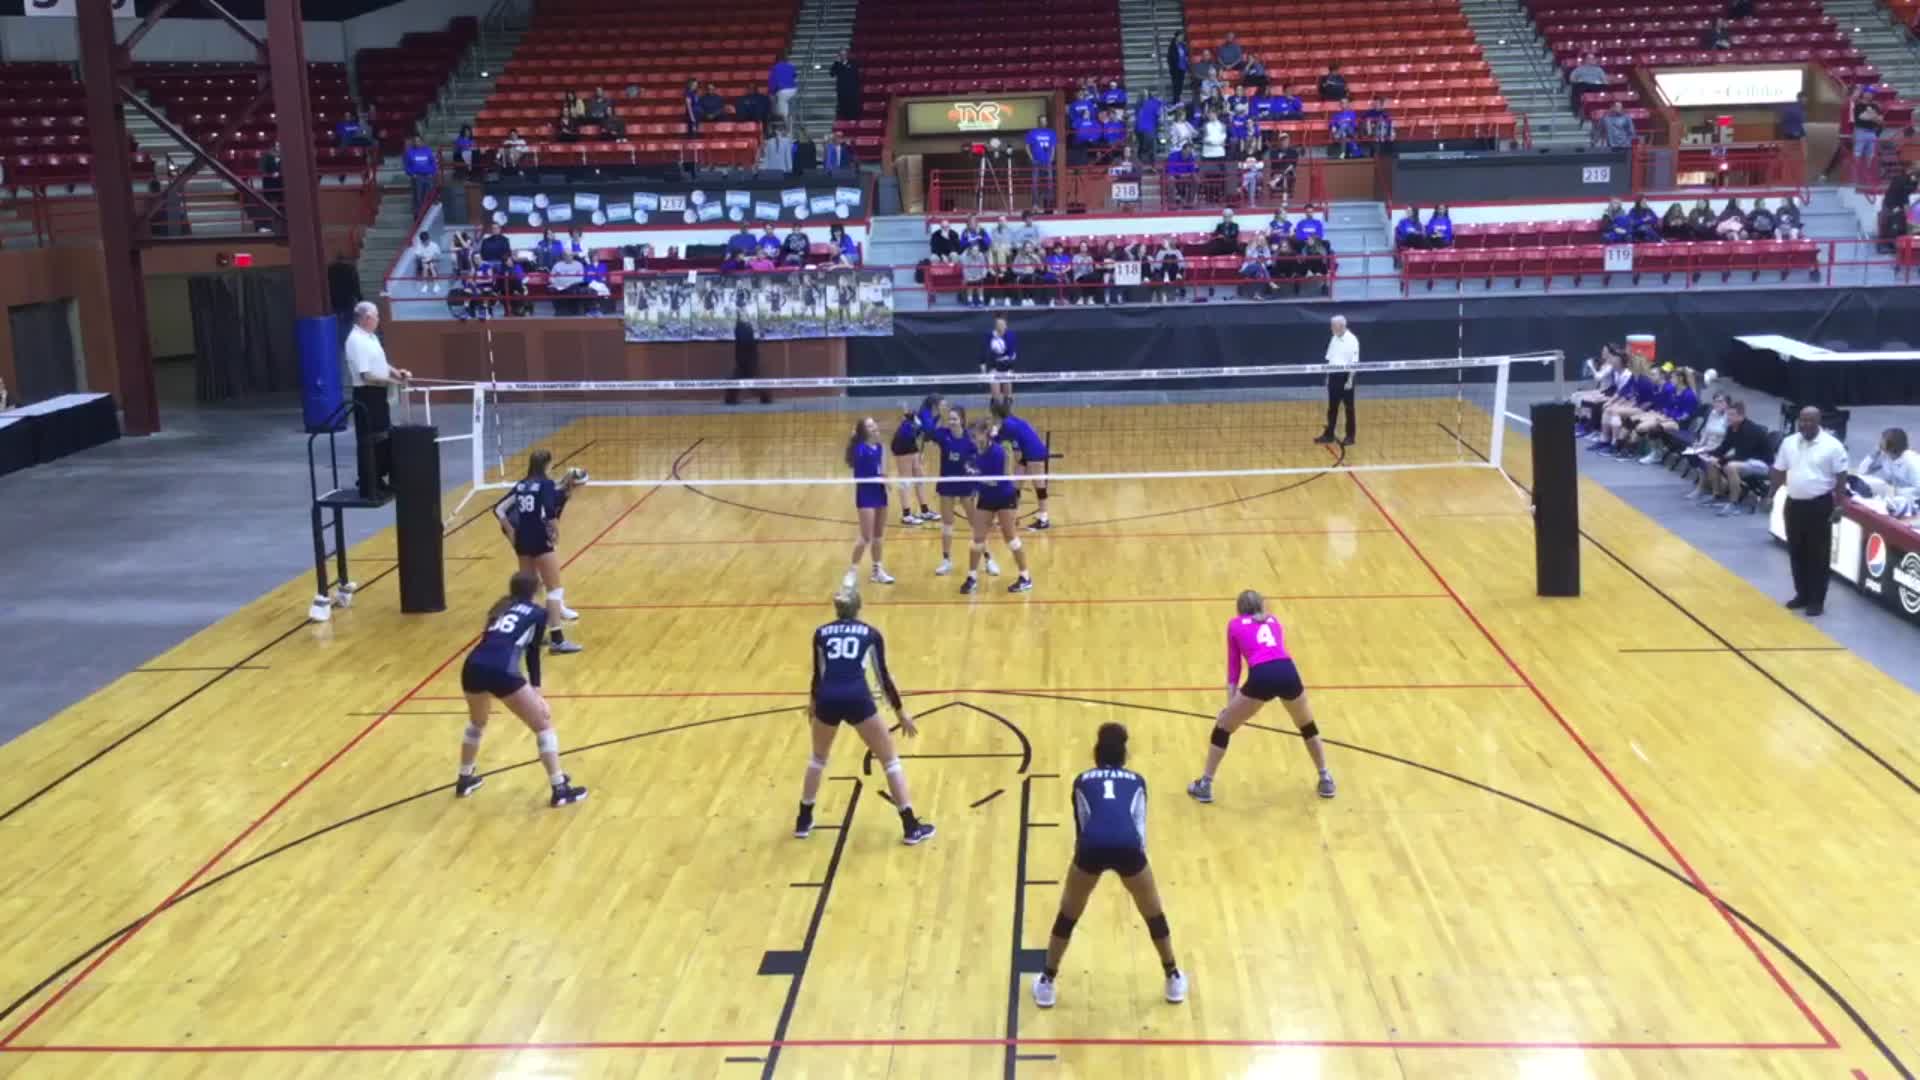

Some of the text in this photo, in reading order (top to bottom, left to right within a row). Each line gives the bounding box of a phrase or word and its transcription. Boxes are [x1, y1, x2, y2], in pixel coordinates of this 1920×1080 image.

[954, 101, 1000, 122] TYR
[1584, 169, 1608, 181] 219
[1114, 185, 1136, 198] 218
[663, 199, 686, 209] 217
[1608, 249, 1632, 261] 119
[518, 494, 535, 512] 38
[1256, 623, 1278, 648] 4
[826, 636, 860, 660] 30
[1103, 779, 1116, 799] 1
